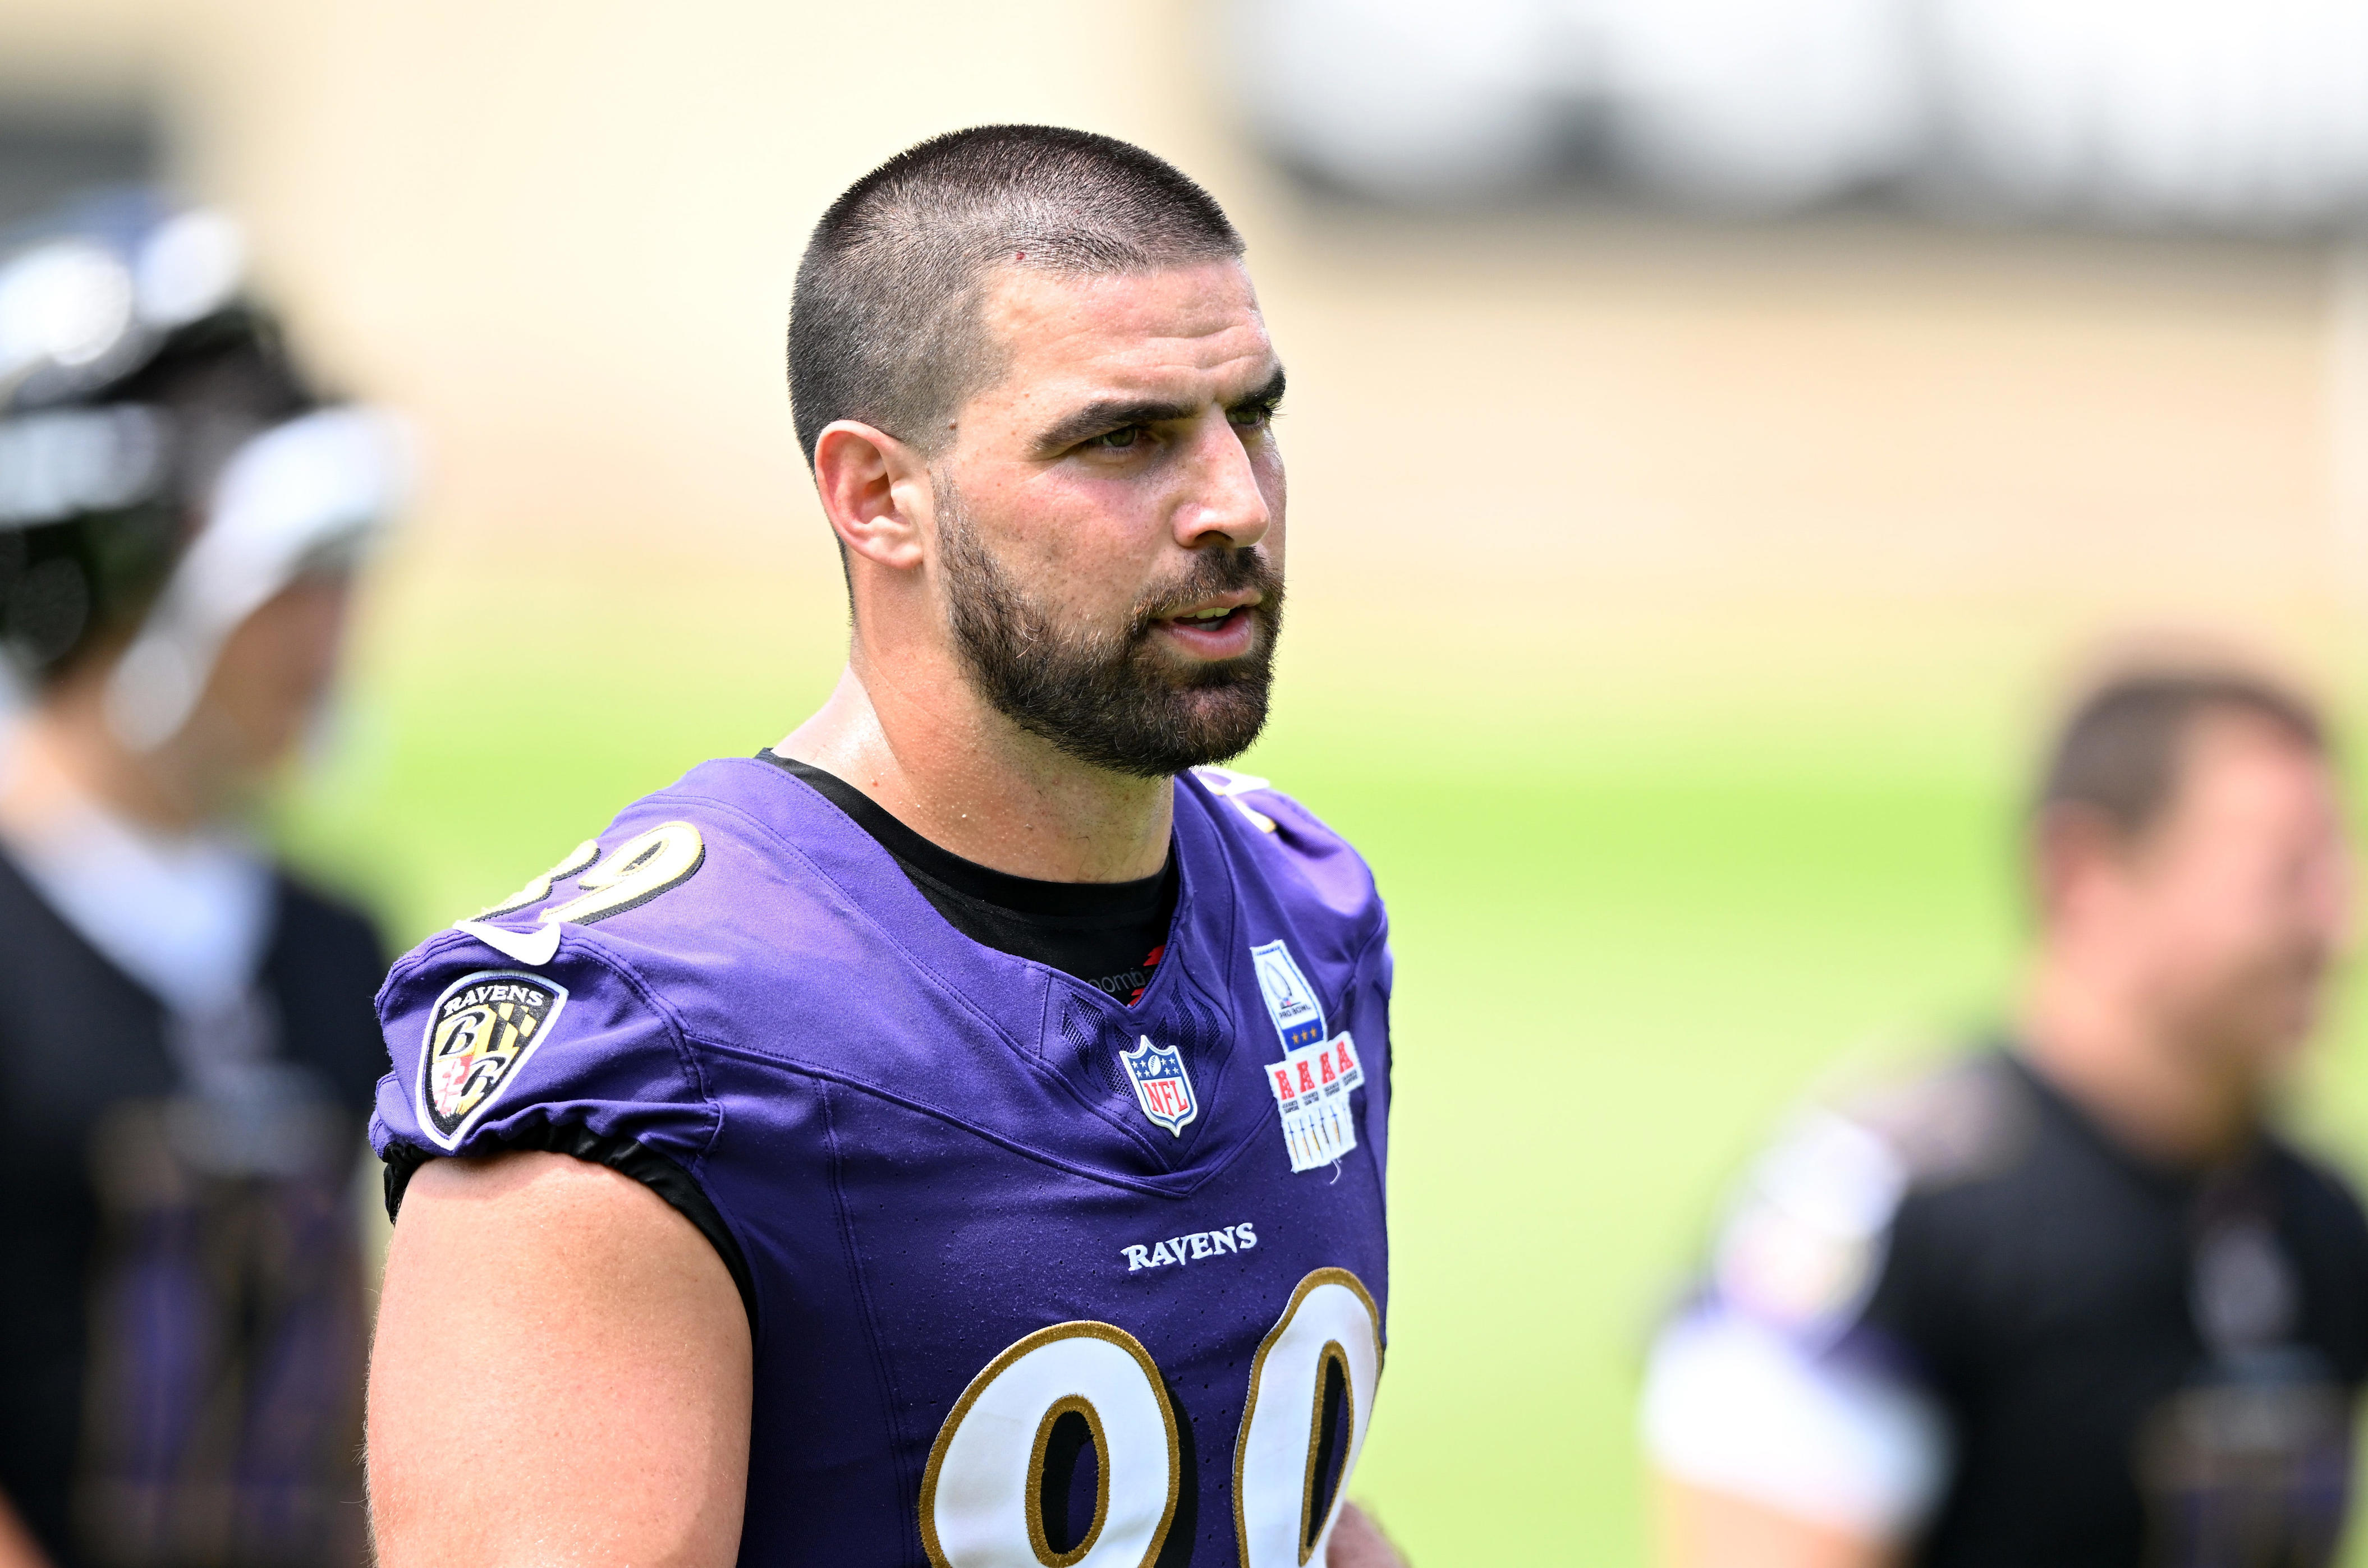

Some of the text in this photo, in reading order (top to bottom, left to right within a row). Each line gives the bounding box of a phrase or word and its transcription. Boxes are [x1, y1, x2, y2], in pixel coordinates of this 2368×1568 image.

[443, 985, 545, 1018] RAVENS
[1279, 1004, 1311, 1019] PRO BOWL
[1143, 1080, 1188, 1117] NFL
[1120, 1222, 1258, 1271] RAVENS
